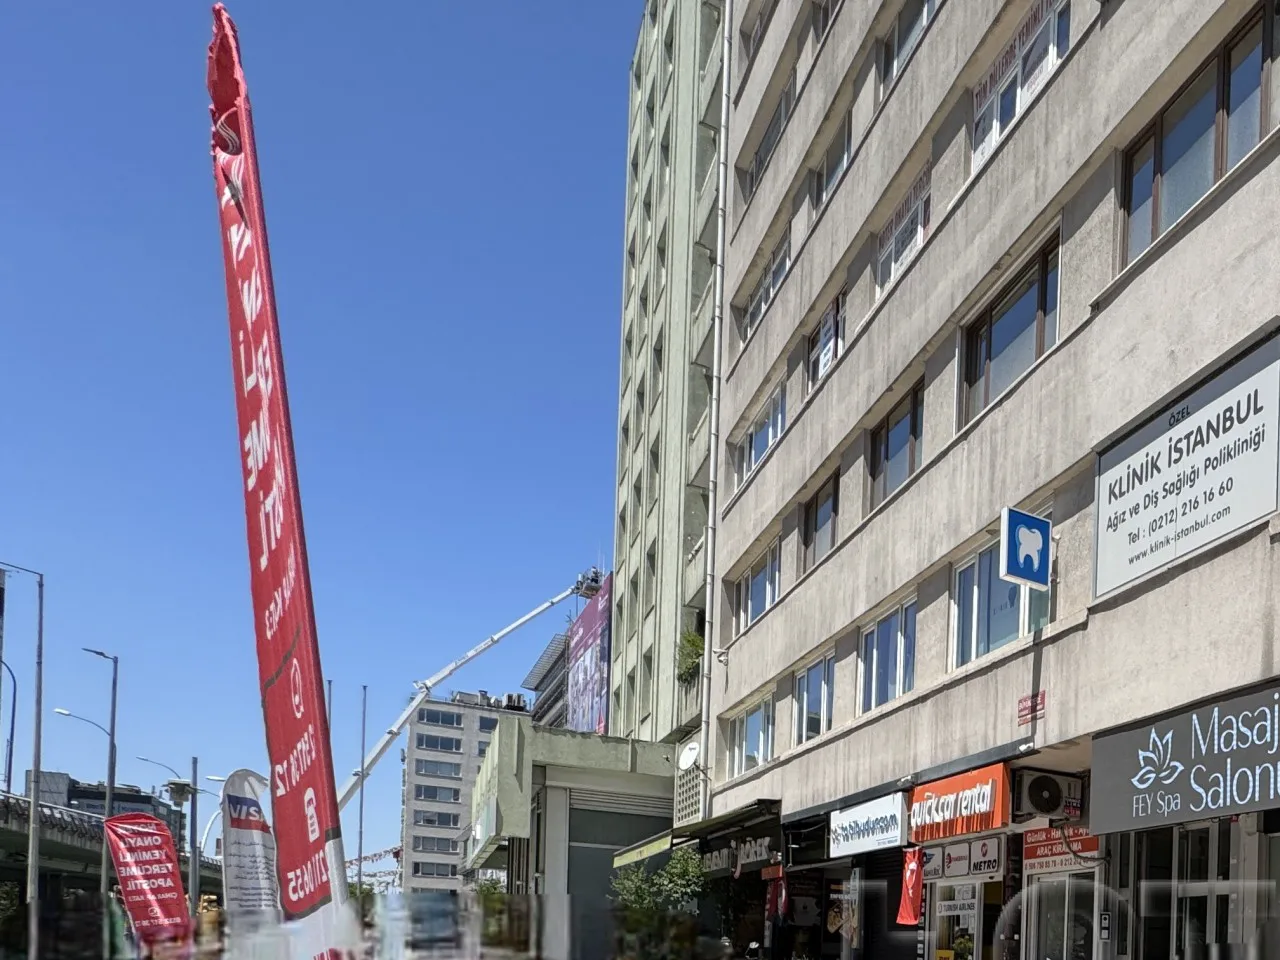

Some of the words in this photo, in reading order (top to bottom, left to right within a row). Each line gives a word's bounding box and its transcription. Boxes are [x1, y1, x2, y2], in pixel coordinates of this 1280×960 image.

[1168, 405, 1191, 427] ÖZEL
[1107, 451, 1162, 504] KLİNİK
[1167, 388, 1265, 468] İSTANBUL
[1106, 509, 1127, 532] Ağız
[1128, 504, 1140, 517] ve
[1143, 492, 1159, 509] Diş
[1162, 466, 1200, 499] Sağlığı
[1203, 424, 1266, 476] Polikliniği
[1127, 529, 1140, 546] Tel
[1148, 510, 1178, 538] (0212)
[1181, 496, 1200, 517] 216
[1202, 486, 1215, 504] 16
[1218, 477, 1234, 496] 60
[1128, 505, 1231, 565] www.klinik-istanbul.com
[1191, 692, 1279, 760] Masaj
[911, 791, 940, 831] quick
[938, 793, 958, 822] car
[956, 778, 993, 819] rental
[1133, 793, 1153, 818] FEY
[1156, 790, 1181, 818] Spa
[972, 859, 998, 872] METRO
[1052, 841, 1083, 854] KİRAAMA
